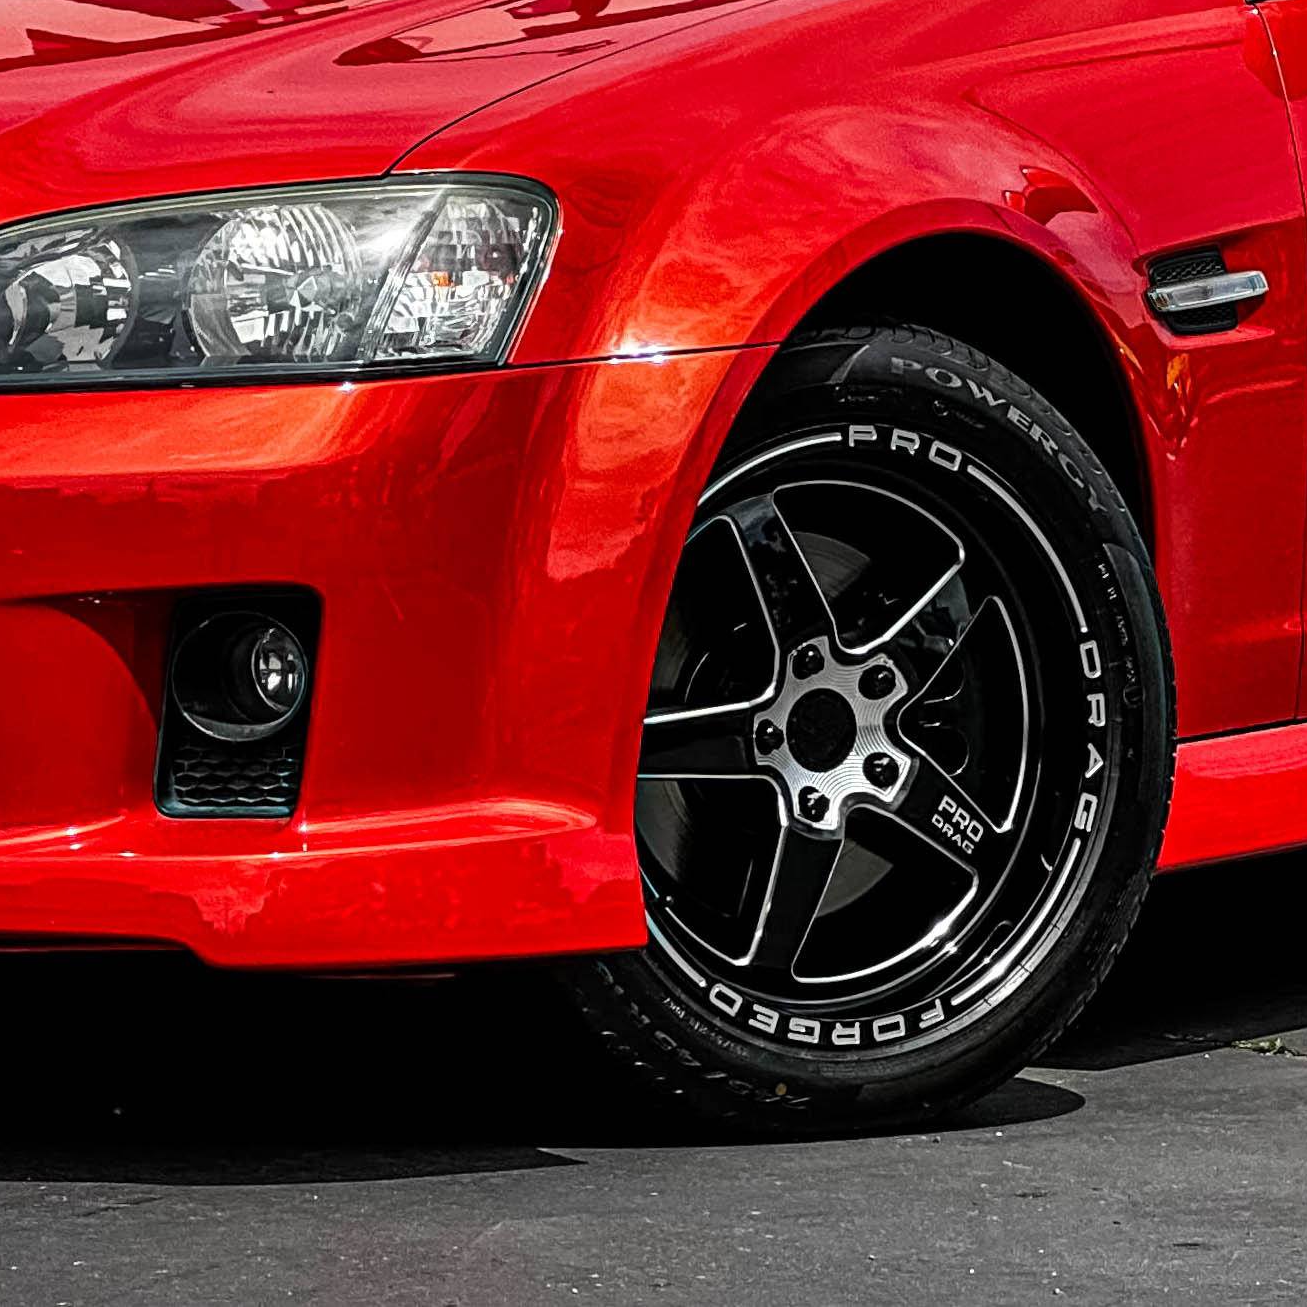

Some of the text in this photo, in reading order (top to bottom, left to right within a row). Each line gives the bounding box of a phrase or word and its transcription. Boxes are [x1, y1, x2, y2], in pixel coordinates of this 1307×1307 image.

[849, 425, 962, 471] PRO
[1074, 640, 1106, 832] DRAG
[931, 813, 975, 855] DRAG
[938, 794, 984, 843] PRO
[709, 982, 945, 1045] FORGED
